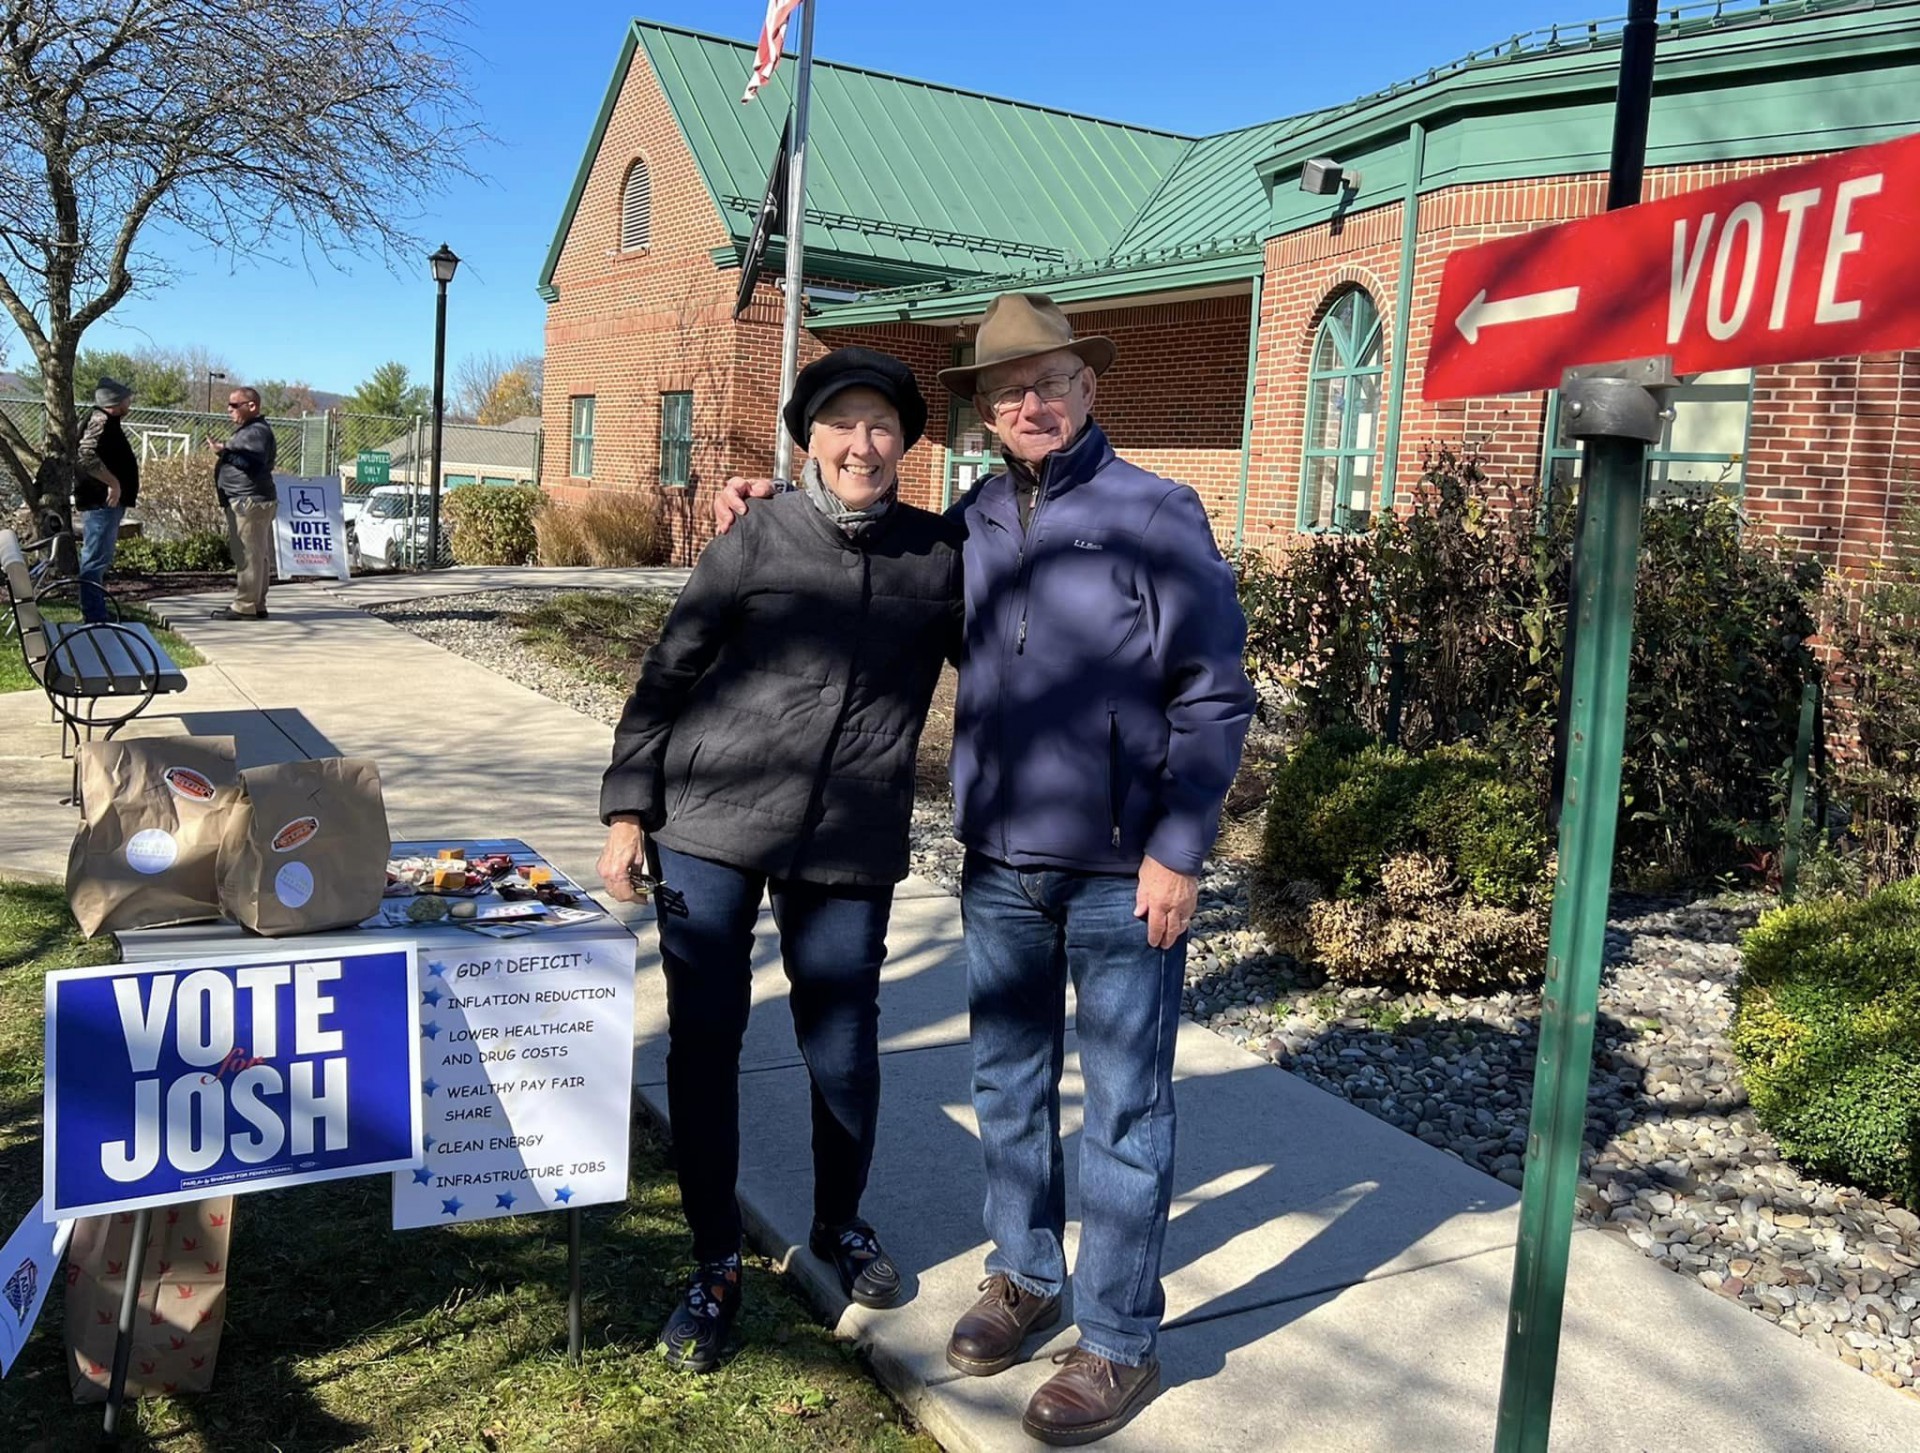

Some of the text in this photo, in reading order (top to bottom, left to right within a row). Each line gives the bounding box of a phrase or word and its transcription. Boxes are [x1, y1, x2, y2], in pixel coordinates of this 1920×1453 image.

[1666, 173, 1884, 344] VOTE
[357, 453, 390, 463] EMPLOYEES
[364, 466, 381, 475] ONLY
[290, 521, 331, 535] VOTE
[292, 537, 332, 551] HERE
[456, 953, 582, 978] GDP DEFICIT
[448, 987, 616, 1009] INFLATION REDUCTION
[112, 960, 343, 1073] VOTE
[449, 1021, 594, 1043] LOWER HEALTHCARE
[200, 1047, 265, 1085] for
[442, 1046, 569, 1066] AND DRUG COSTS
[448, 1076, 585, 1099] WEALTHY PAY FAIR
[101, 1057, 349, 1183] JOSH
[445, 1106, 492, 1121] SHARE
[437, 1135, 544, 1154] CLEAN ENERGY
[436, 1161, 606, 1188] INFRASTRUCTURE JOBS
